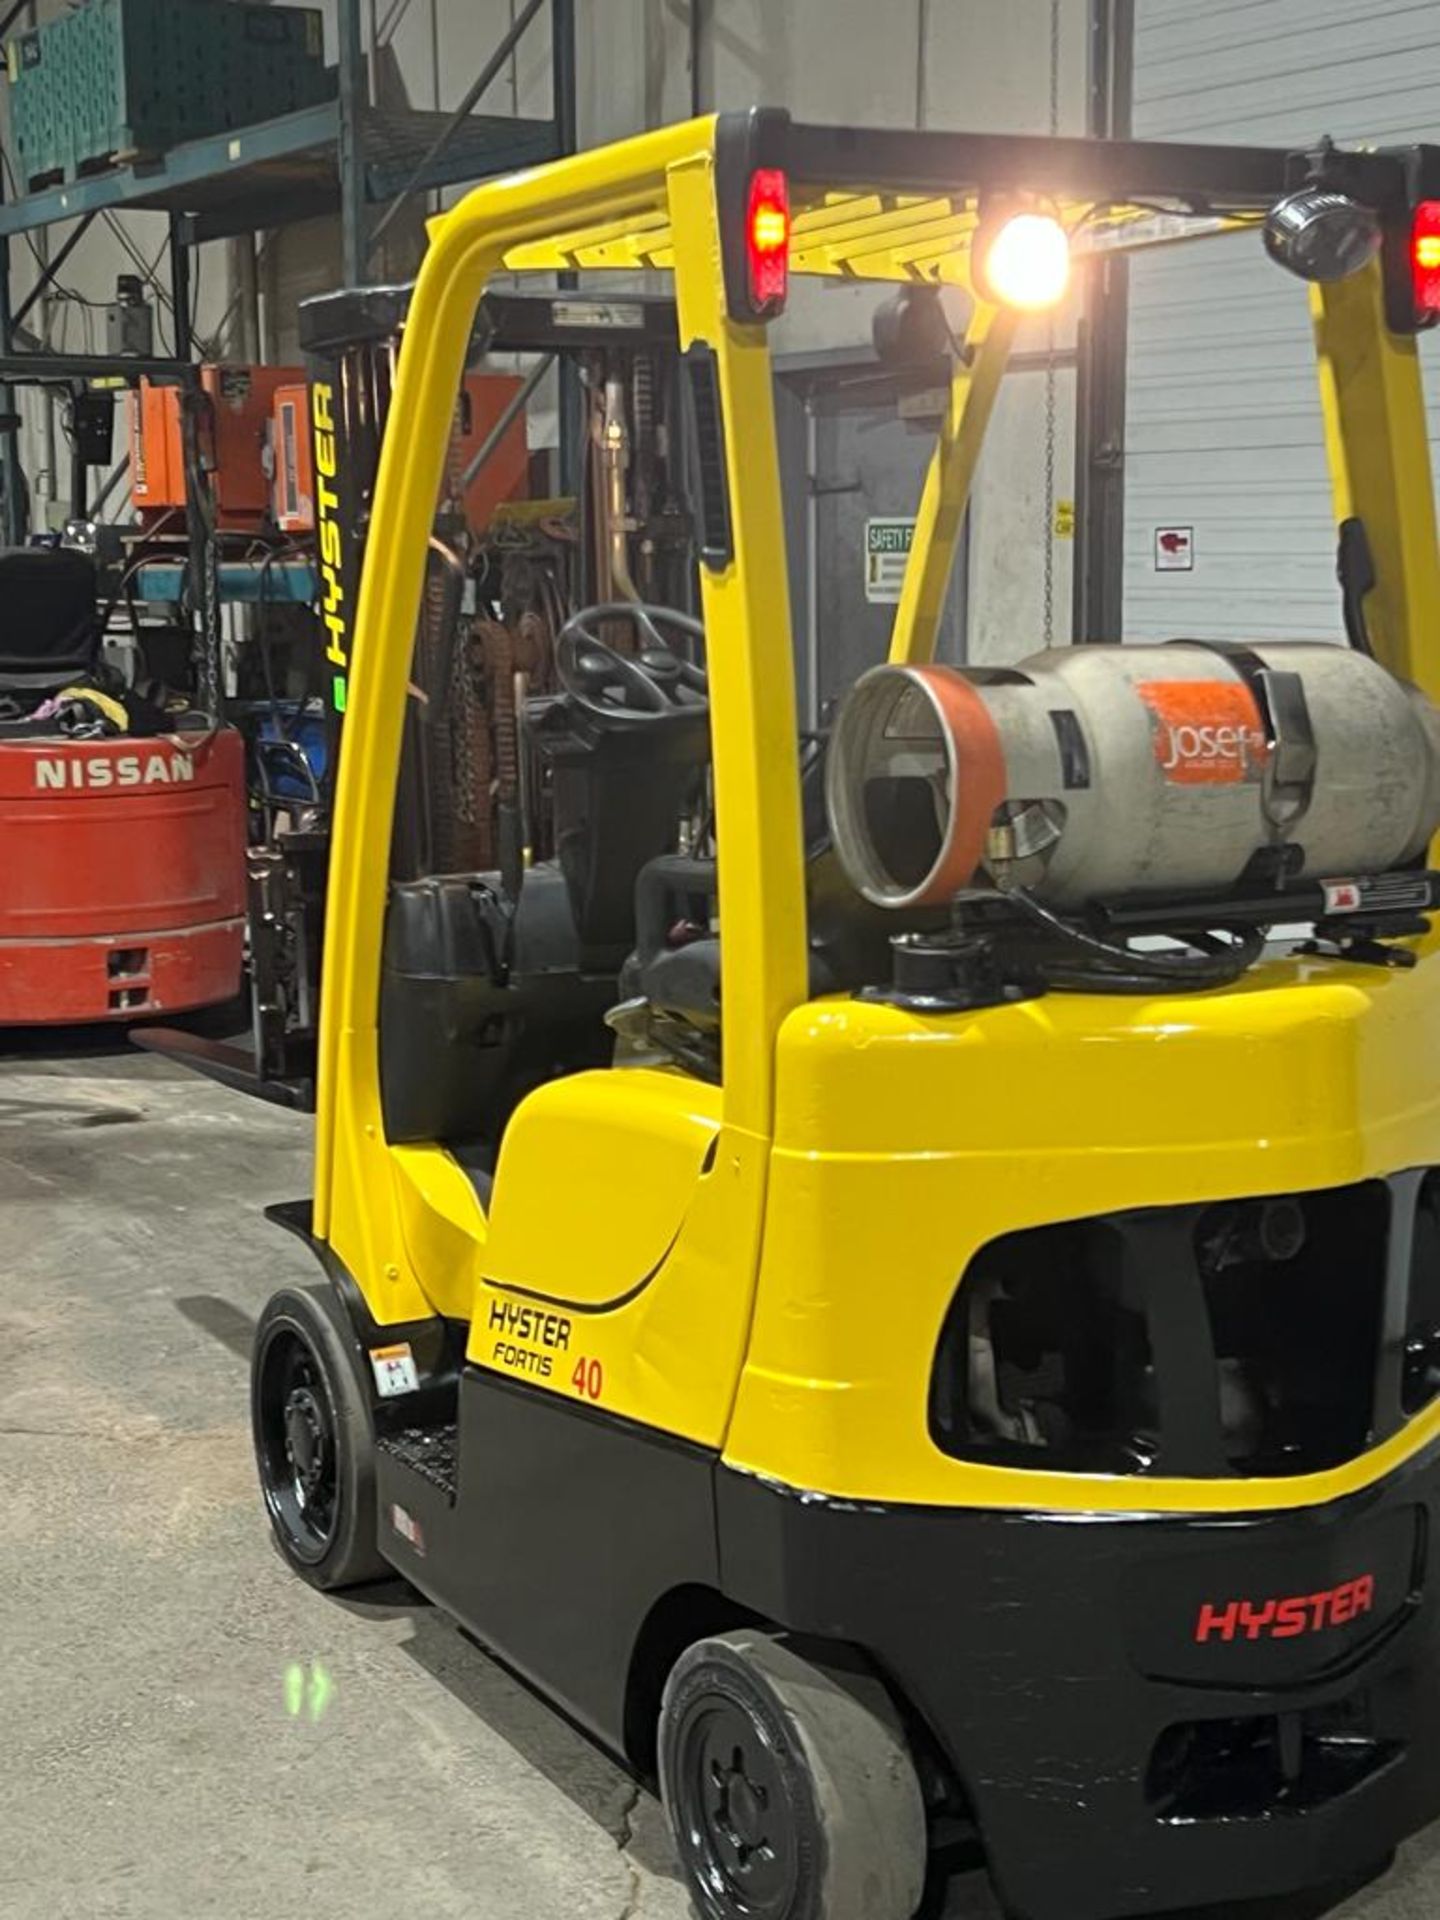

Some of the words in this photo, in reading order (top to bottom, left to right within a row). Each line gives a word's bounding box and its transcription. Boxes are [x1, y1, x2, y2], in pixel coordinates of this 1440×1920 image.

[312, 383, 347, 667] HYSTER
[870, 528, 904, 549] SAFETY
[35, 753, 194, 788] NISSAN
[489, 1299, 571, 1351] HYSTER
[493, 1342, 553, 1377] FORTIS
[572, 1357, 602, 1400] 40
[1196, 1574, 1373, 1641] HYSTER
